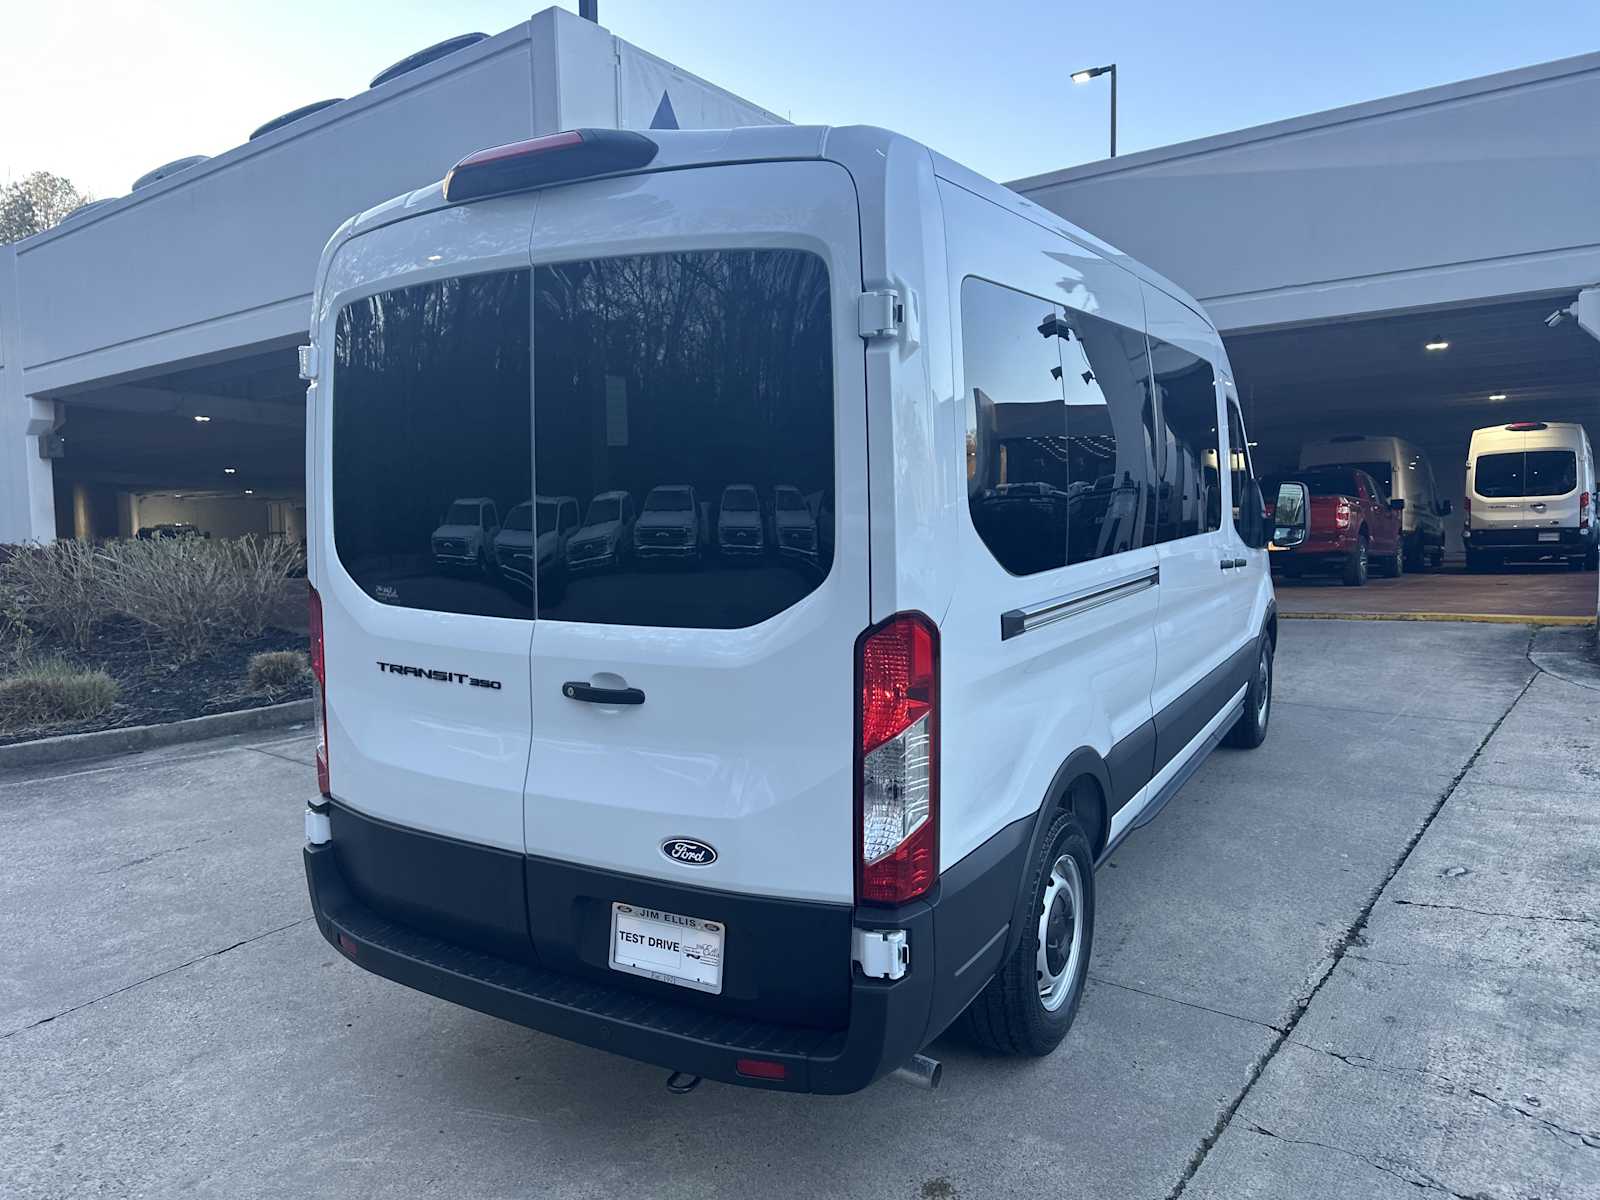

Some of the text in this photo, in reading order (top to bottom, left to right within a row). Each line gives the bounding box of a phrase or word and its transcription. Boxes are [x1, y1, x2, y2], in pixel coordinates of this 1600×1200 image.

[376, 661, 502, 690] TRANSIT 350
[671, 842, 705, 862] Ford
[640, 909, 659, 920] JIM
[664, 915, 696, 927] ELLIS
[619, 930, 680, 953] TEST DRIVE
